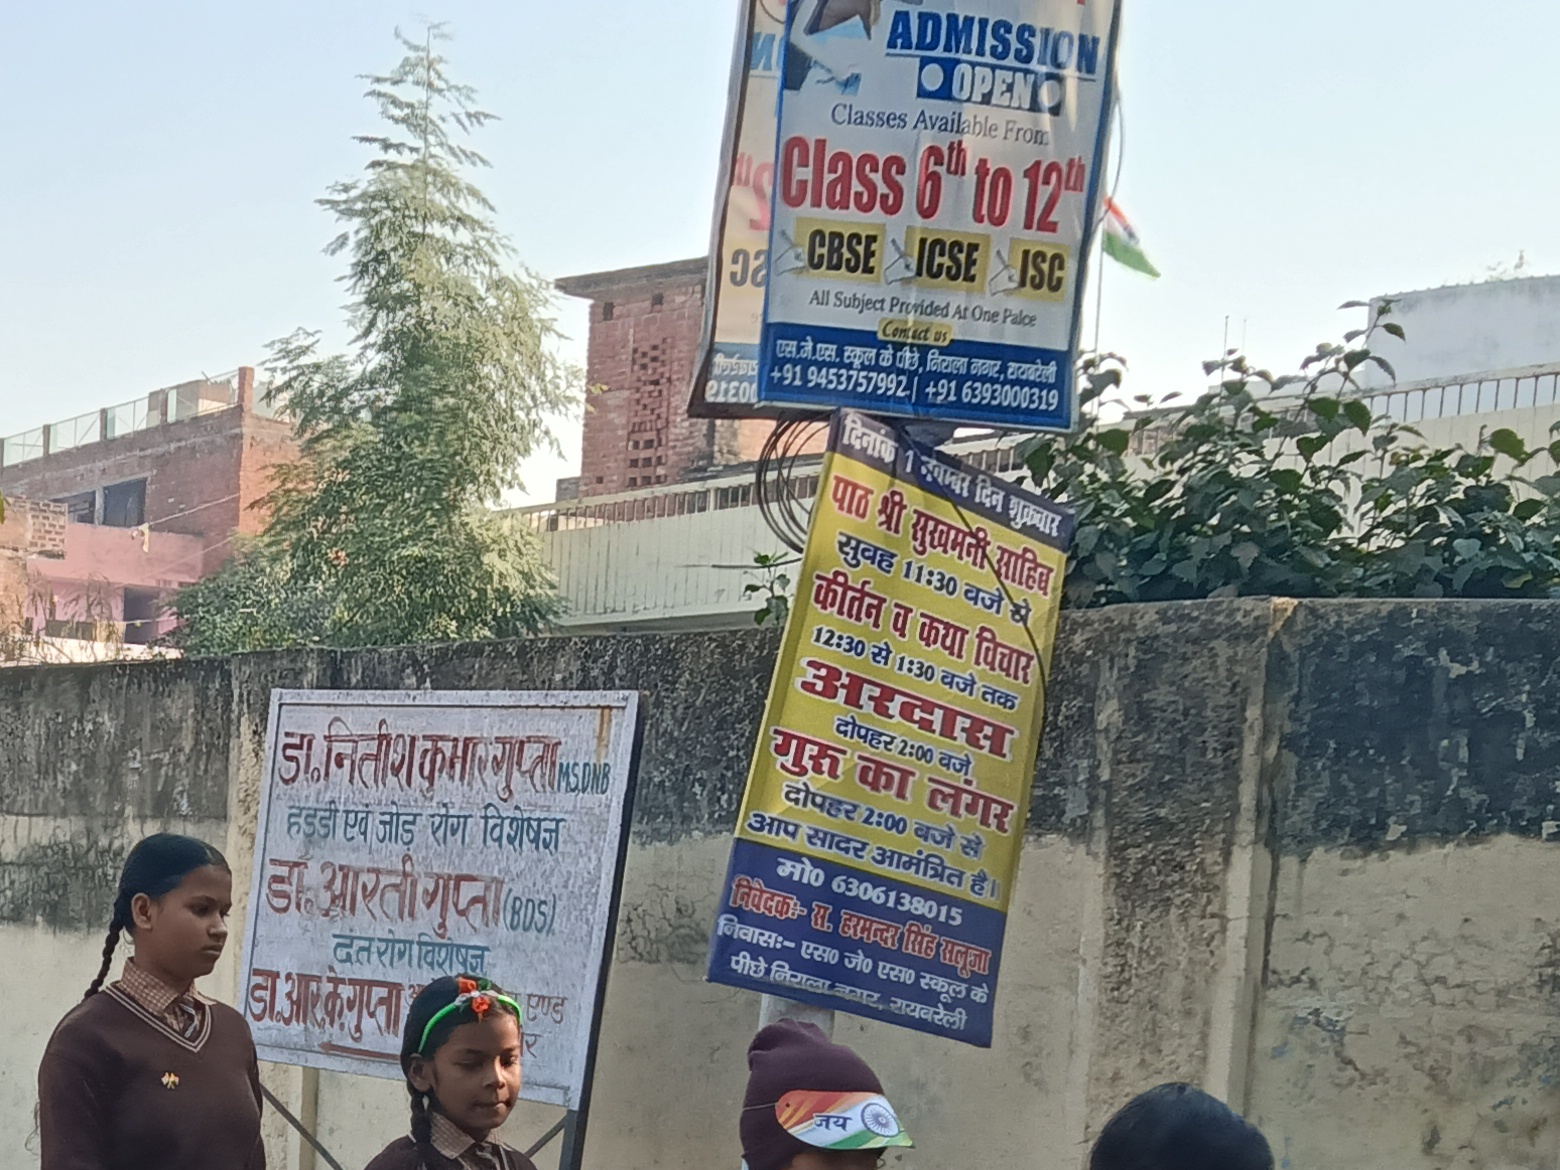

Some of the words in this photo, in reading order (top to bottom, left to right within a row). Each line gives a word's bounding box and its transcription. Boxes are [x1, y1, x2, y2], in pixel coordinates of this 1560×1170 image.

[887, 9, 1100, 75] ADMISSION
[952, 62, 1038, 108] OPEN
[831, 103, 908, 130] Classes
[911, 109, 998, 140] Available
[1002, 119, 1050, 146] From
[781, 136, 907, 216] Class
[972, 157, 1014, 228] to
[807, 229, 878, 275] CBSE
[916, 237, 980, 283] ICSE
[1019, 248, 1066, 293] ISC
[809, 289, 830, 306] All
[833, 292, 885, 314] Subject
[889, 297, 949, 319] Provided
[952, 304, 969, 320] At
[971, 305, 999, 323] One
[1001, 308, 1038, 327] Palce
[882, 320, 930, 342] Contact
[933, 330, 948, 344] us
[843, 345, 876, 373] स्कूल
[879, 345, 892, 368] के
[770, 364, 802, 386] +91
[807, 366, 908, 397] 9453757992
[925, 379, 957, 402] +91
[961, 381, 1059, 412] 6393000319
[842, 415, 898, 464] दिनांक
[831, 474, 875, 520] पाठ
[877, 489, 907, 535] श्री
[912, 507, 991, 571] सुखमनी
[902, 560, 959, 597] 11:30
[812, 568, 887, 630] कीर्तन
[975, 625, 1035, 685] विचार
[813, 625, 866, 658] 12:30
[870, 640, 891, 667] से
[896, 654, 935, 682] 1:30
[981, 683, 1020, 711] तक
[799, 658, 1017, 760] अरदास
[835, 715, 896, 755] दोपहर
[898, 738, 935, 764] 2:00
[855, 751, 917, 801] का
[926, 776, 1017, 835] लंगर
[342, 802, 373, 845] एवं
[376, 801, 424, 852] जोड़
[428, 802, 474, 847] रोग
[783, 781, 859, 822] दोपहर
[862, 805, 908, 836] 2:00
[960, 830, 984, 860] से
[746, 811, 801, 841] आप
[806, 824, 869, 859] सादर
[871, 843, 966, 890] आमंत्रित
[831, 874, 964, 927] 6306138015
[903, 919, 940, 959] सिंह
[730, 951, 769, 979] पीछे
[919, 971, 968, 1004] स्कूल
[970, 981, 989, 1005] के
[813, 1112, 853, 1132] जय
